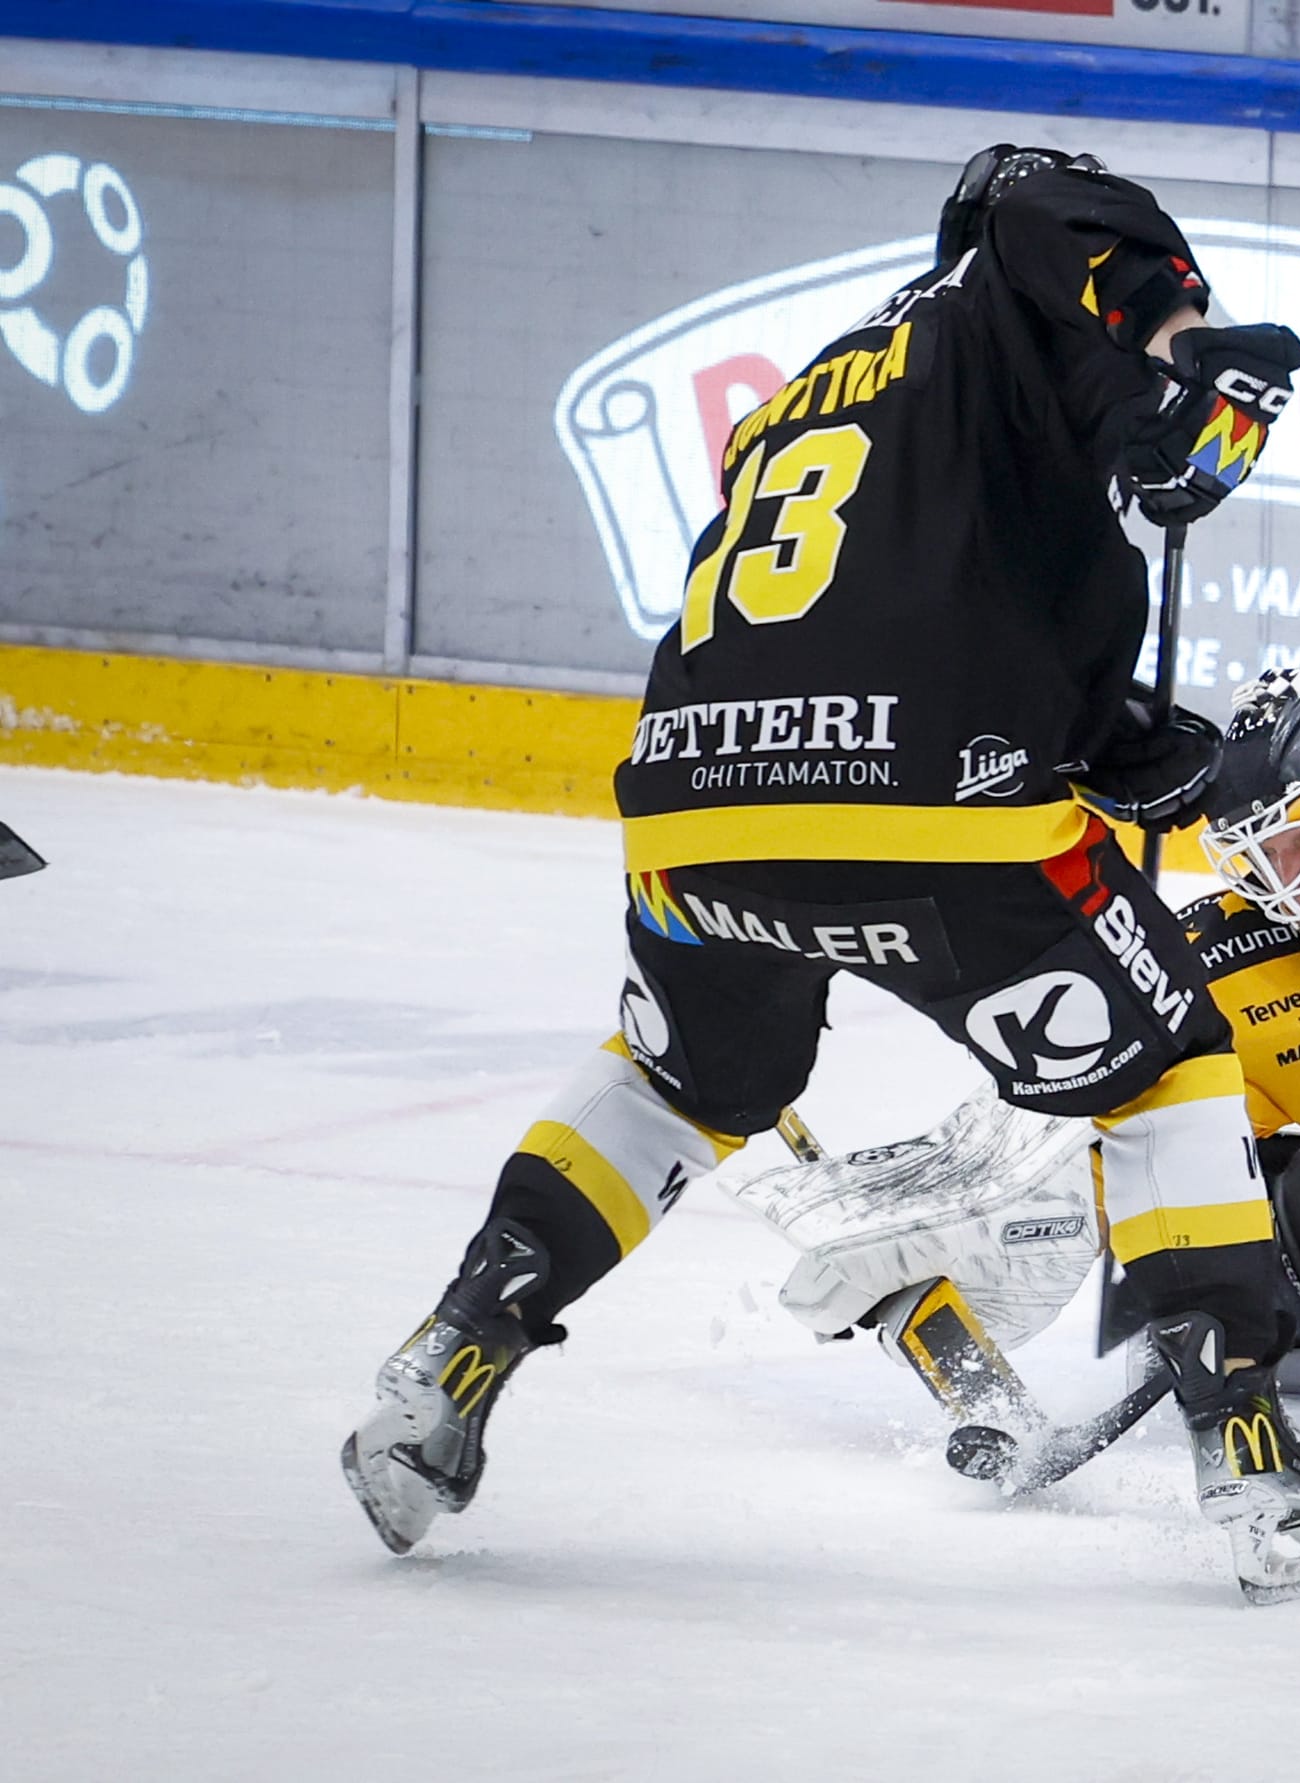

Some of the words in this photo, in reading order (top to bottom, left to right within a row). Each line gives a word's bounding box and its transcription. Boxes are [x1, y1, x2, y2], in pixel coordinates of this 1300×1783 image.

[691, 759, 899, 790] OHITTAMATON.
[955, 748, 1030, 801] Liiga
[1012, 1040, 1144, 1097] Karkkainen.com
